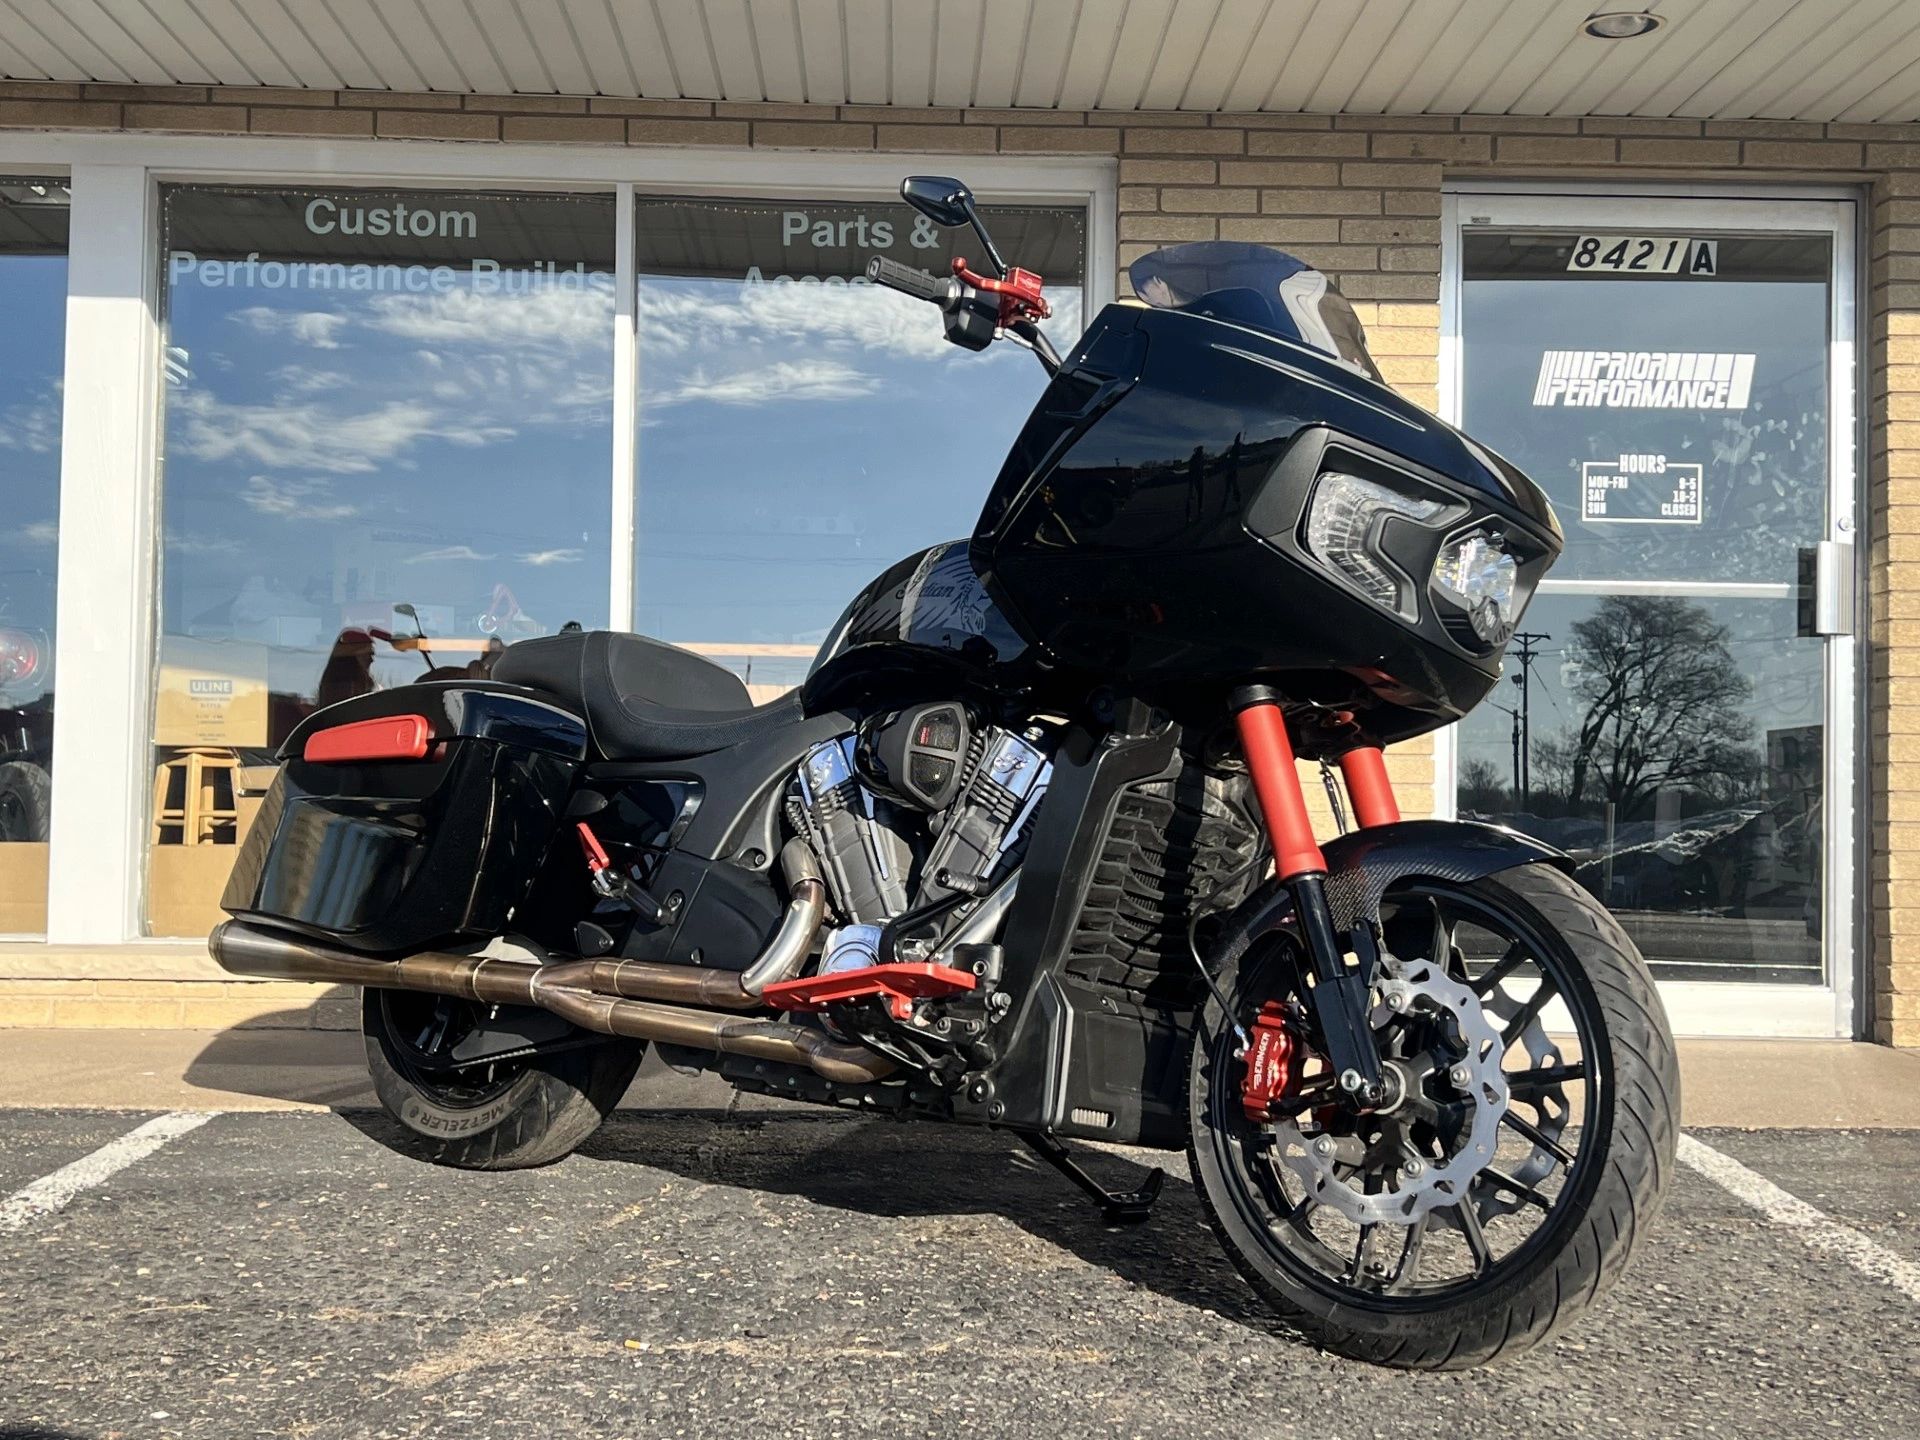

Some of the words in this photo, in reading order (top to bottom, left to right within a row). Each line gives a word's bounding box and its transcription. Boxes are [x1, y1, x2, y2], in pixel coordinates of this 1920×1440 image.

[305, 199, 477, 238] Custom
[783, 211, 894, 248] Parts
[909, 214, 940, 249] &
[1574, 238, 1679, 270] 8421
[1692, 242, 1715, 273] A
[169, 250, 456, 293] Performance
[472, 258, 612, 298] Builds
[1591, 352, 1667, 380] PRIOR
[1548, 379, 1730, 408] PERFORMANCE
[1619, 454, 1667, 474] HOURS
[1588, 475, 1628, 489] MON-FRI
[1588, 489, 1606, 501] SAT
[1673, 490, 1697, 503] 10-2
[1587, 502, 1606, 515] SUN
[1661, 503, 1697, 516] CLOSED
[192, 681, 230, 692] ULINE
[1253, 1032, 1271, 1090] BERINGER
[420, 1103, 505, 1132] METZELER
